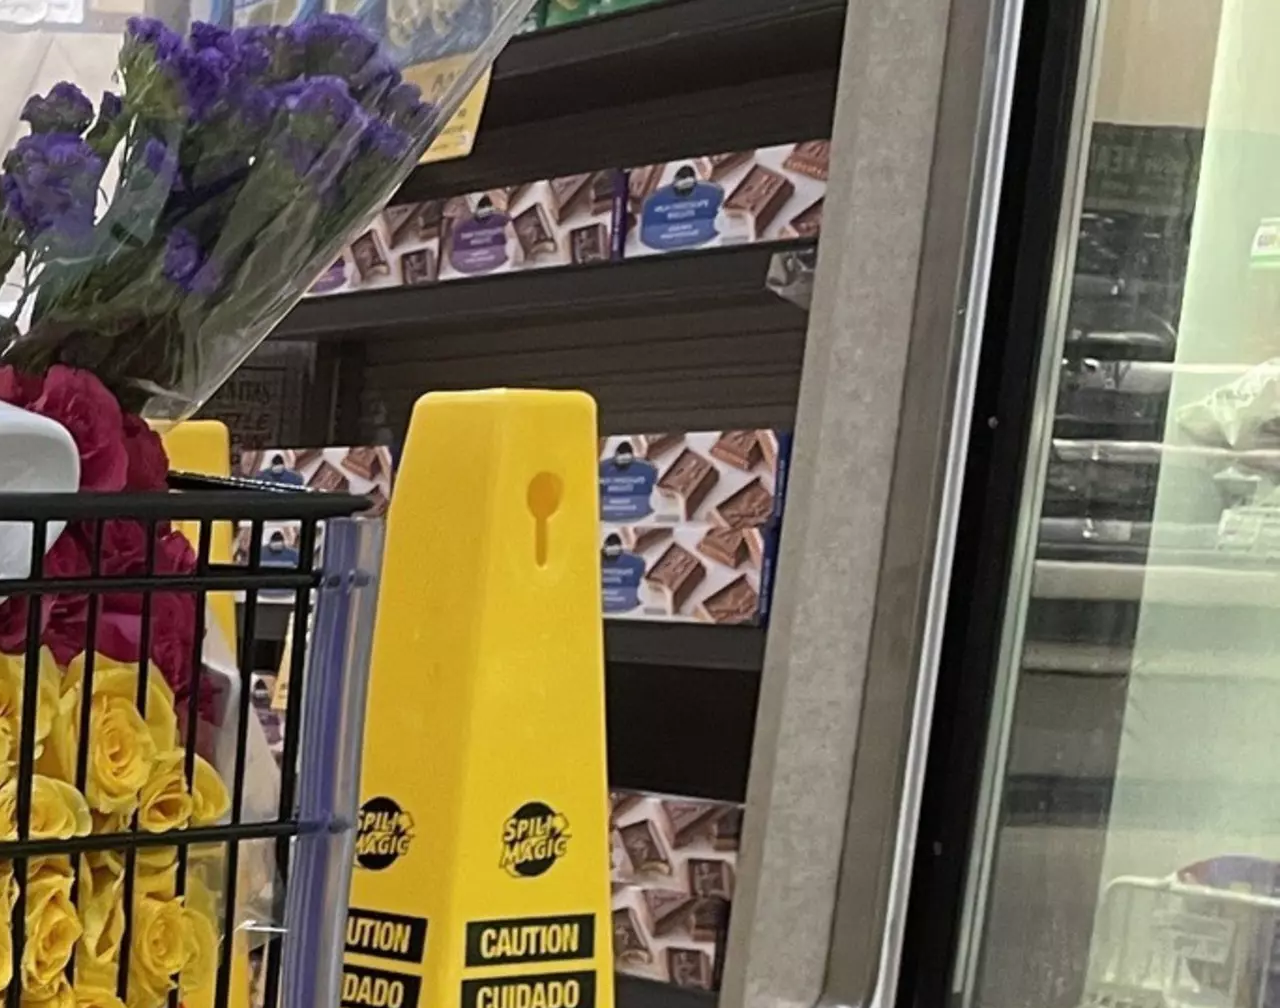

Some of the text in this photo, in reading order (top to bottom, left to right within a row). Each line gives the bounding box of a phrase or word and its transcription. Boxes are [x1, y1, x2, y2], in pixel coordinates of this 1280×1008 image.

[501, 837, 567, 867] MAGIC
[346, 915, 411, 954] UTION
[480, 922, 580, 960] CAUTION
